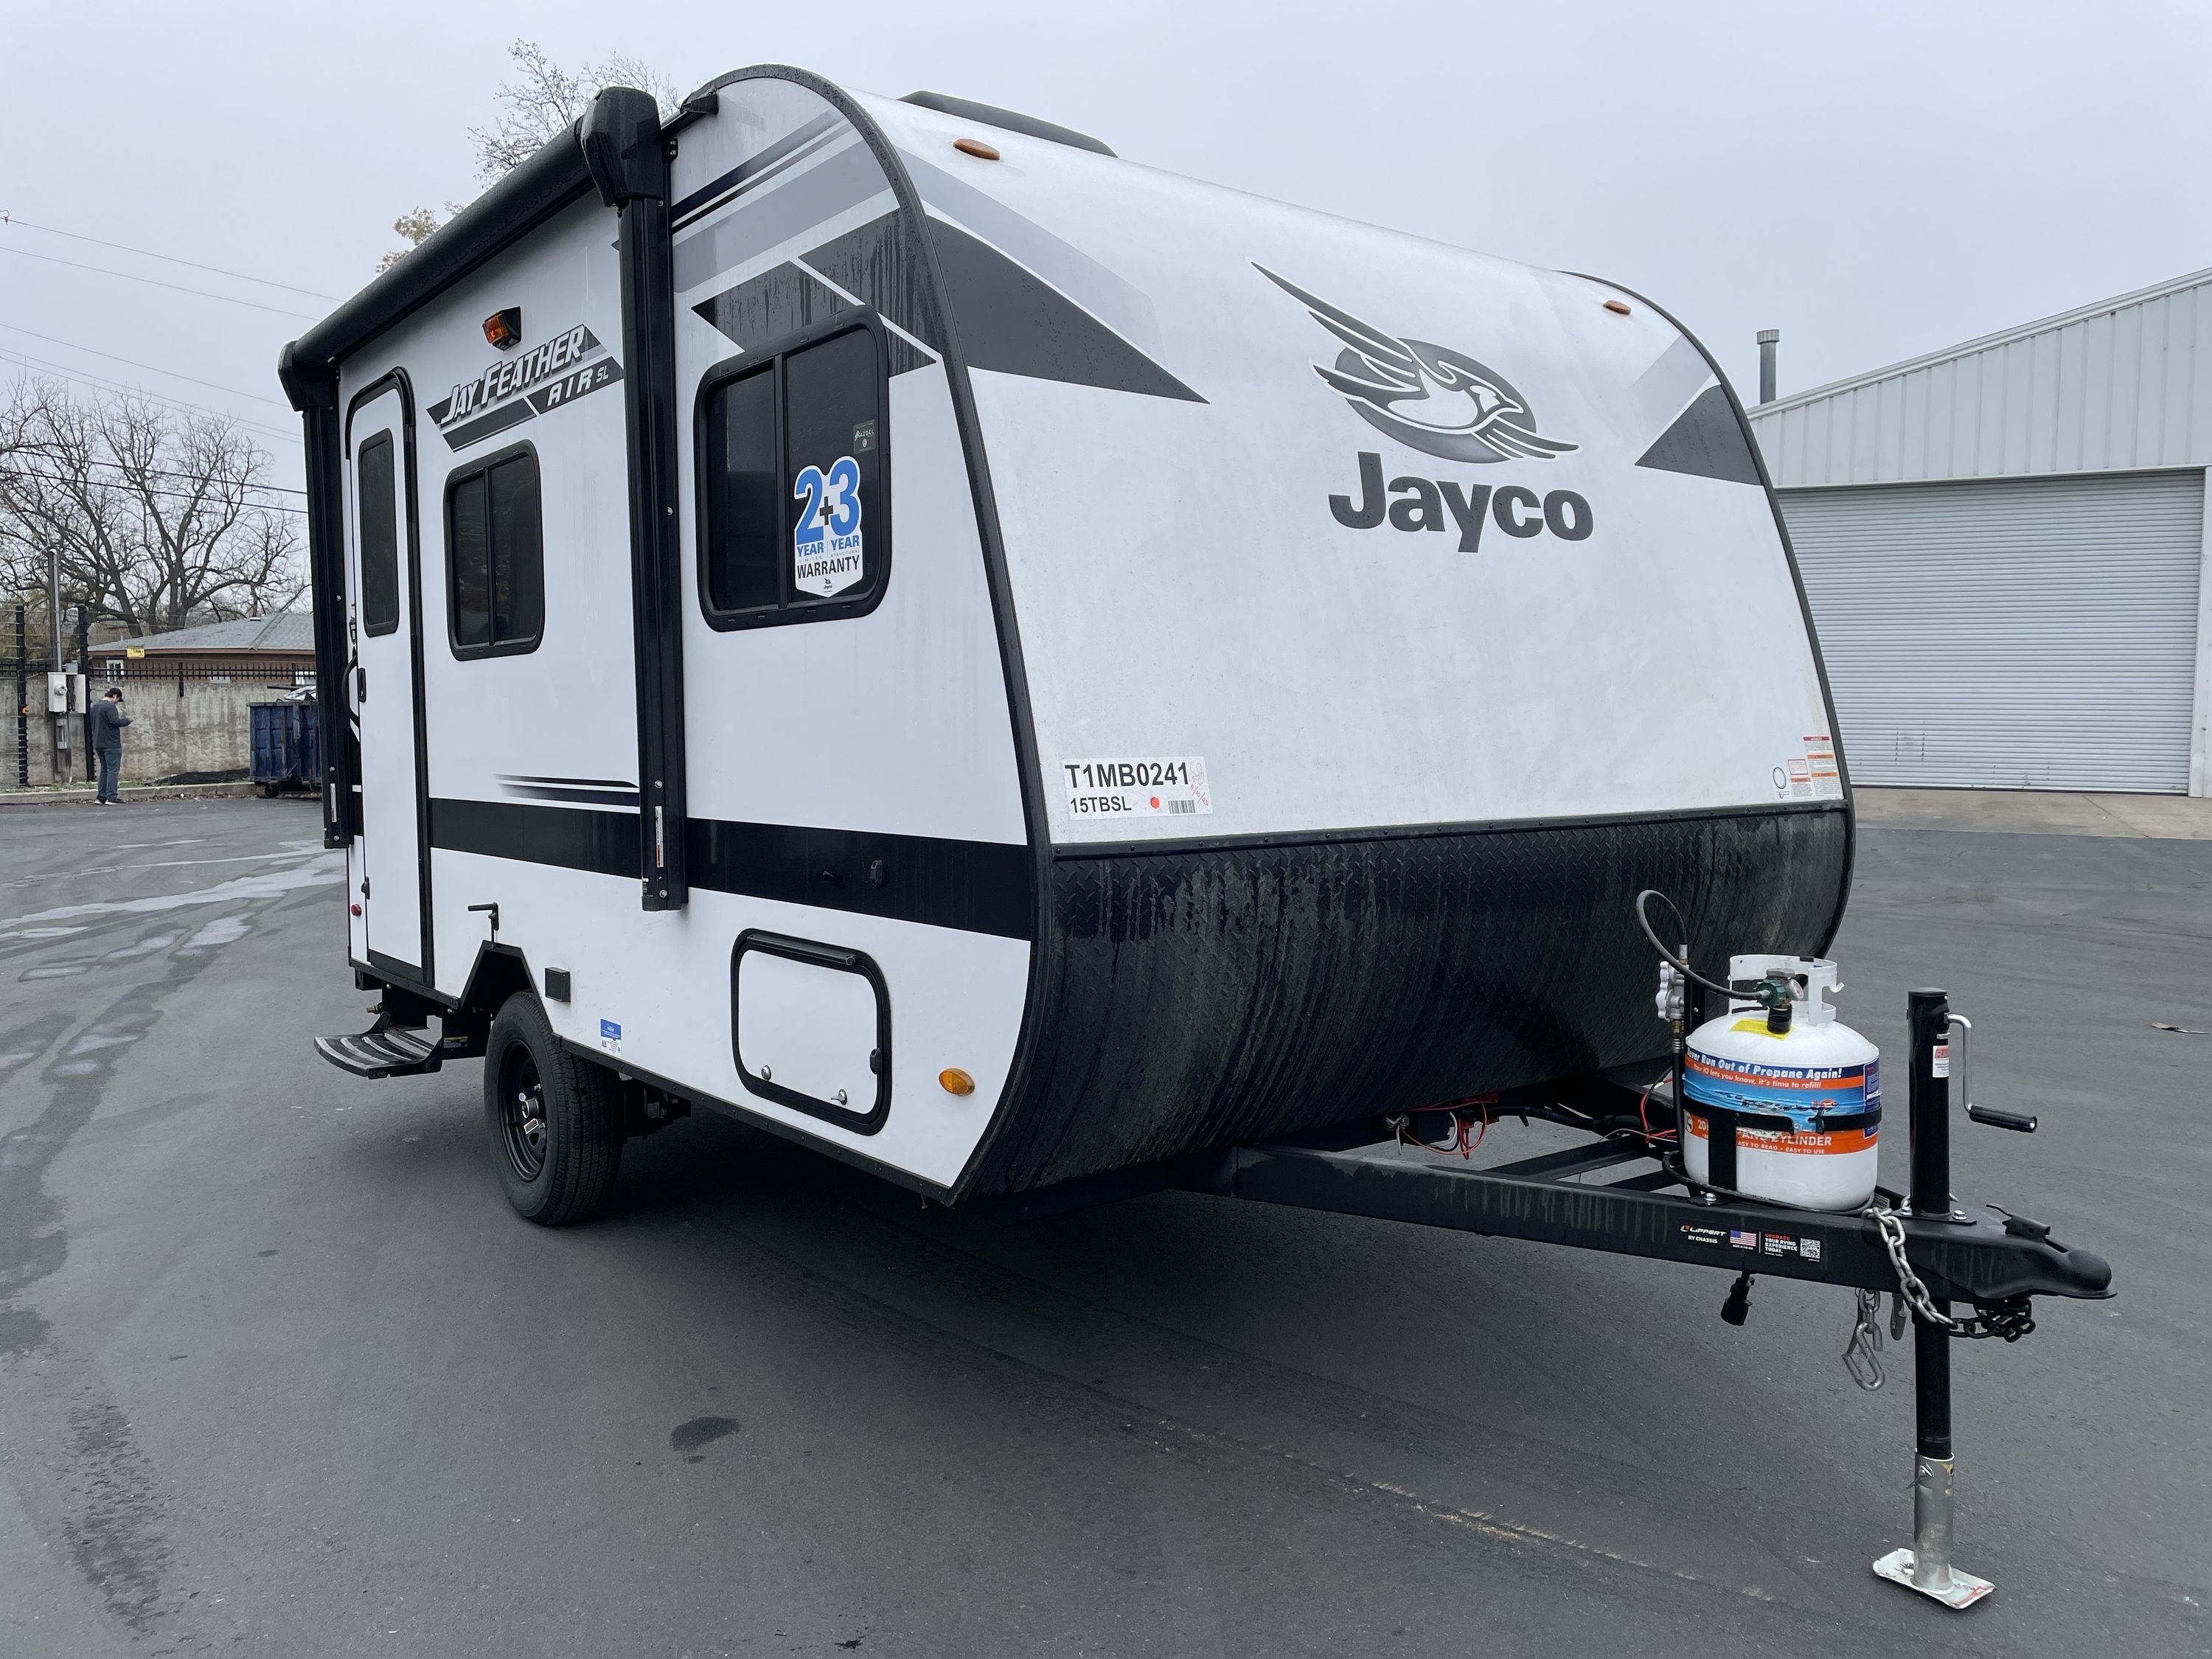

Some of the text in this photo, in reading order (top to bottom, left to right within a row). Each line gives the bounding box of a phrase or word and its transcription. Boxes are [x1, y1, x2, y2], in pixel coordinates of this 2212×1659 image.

[440, 324, 587, 427] JAY FEATHER
[547, 365, 610, 407] AIR SL
[1328, 451, 1594, 553] Jayco
[796, 542, 824, 557] YEAR
[831, 535, 860, 551] YEAR
[799, 555, 823, 563] LIMITED
[830, 549, 860, 558] STRUCTURAL
[797, 554, 860, 580] WARRANTY
[1065, 762, 1189, 788] T1MB0241
[1070, 796, 1132, 813] 15TBSL
[1701, 1054, 1717, 1068] Run
[1718, 1059, 1736, 1071] Out
[1738, 1064, 1751, 1074] of
[1753, 1065, 1804, 1079] Propane
[1806, 1068, 1843, 1082] Again!
[1710, 1068, 1720, 1078] lets
[1734, 1075, 1758, 1086] know,
[1759, 1077, 1771, 1087] it's
[1772, 1079, 1789, 1088] time
[1790, 1081, 1800, 1089] to
[1695, 1236, 1718, 1244] CHASSIS
[1764, 1242, 1798, 1252] EXPERIENCE
